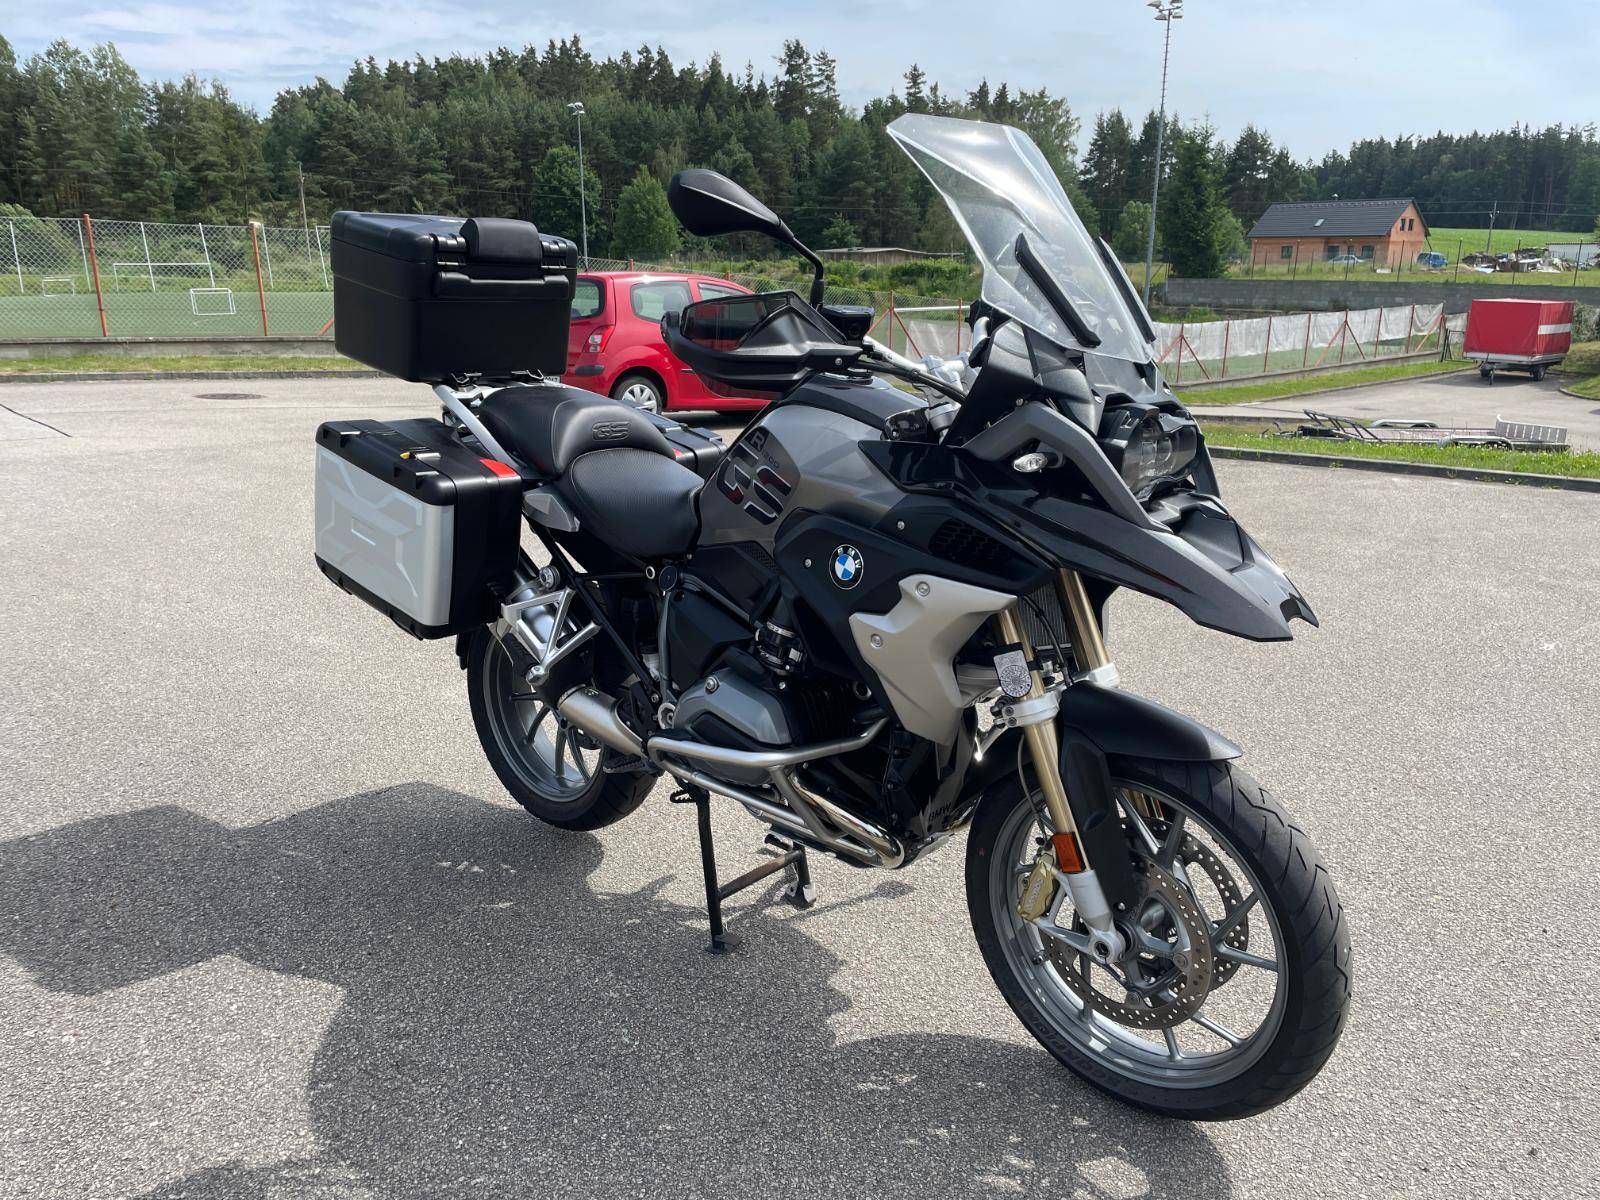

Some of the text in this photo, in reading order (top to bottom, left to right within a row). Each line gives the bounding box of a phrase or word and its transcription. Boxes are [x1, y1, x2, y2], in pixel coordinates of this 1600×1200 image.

[591, 420, 631, 441] GS
[749, 430, 767, 451] R
[716, 441, 792, 525] GS
[837, 547, 862, 569] BMW
